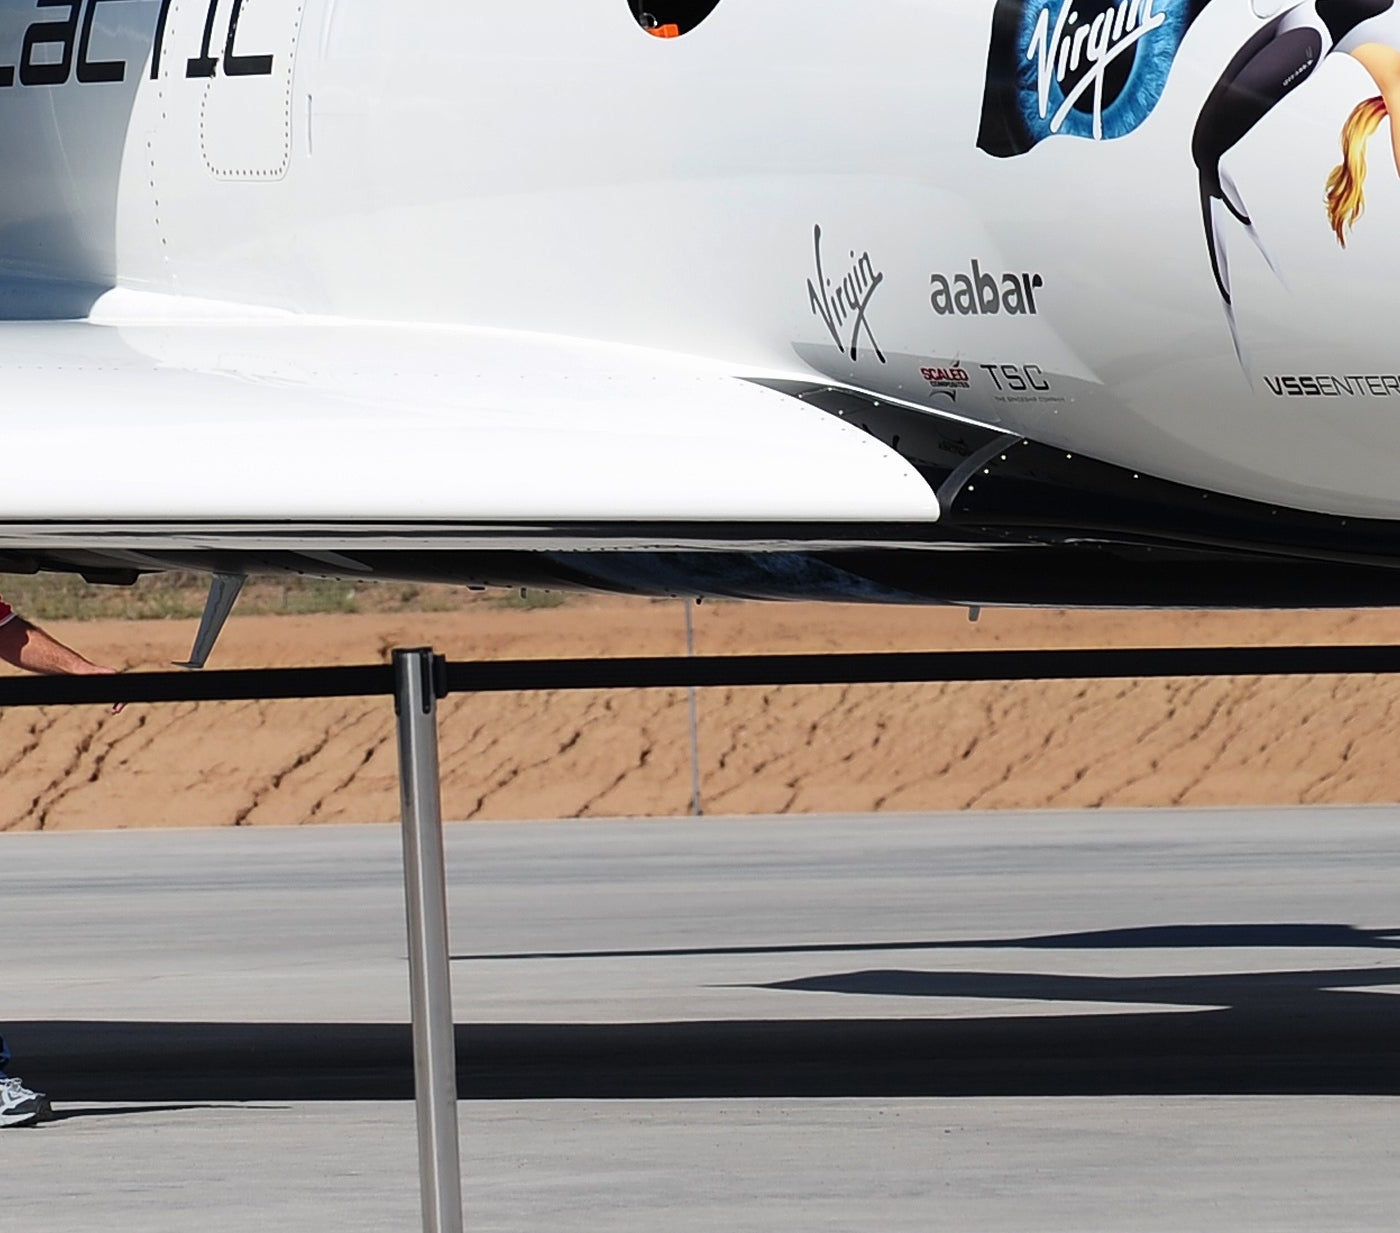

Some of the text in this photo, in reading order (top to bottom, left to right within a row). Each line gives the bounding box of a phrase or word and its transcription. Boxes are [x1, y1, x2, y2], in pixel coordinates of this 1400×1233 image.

[806, 223, 886, 364] Virgin
[930, 259, 1043, 316] aabar
[920, 368, 969, 382] SCALED
[980, 364, 1050, 391] TSC
